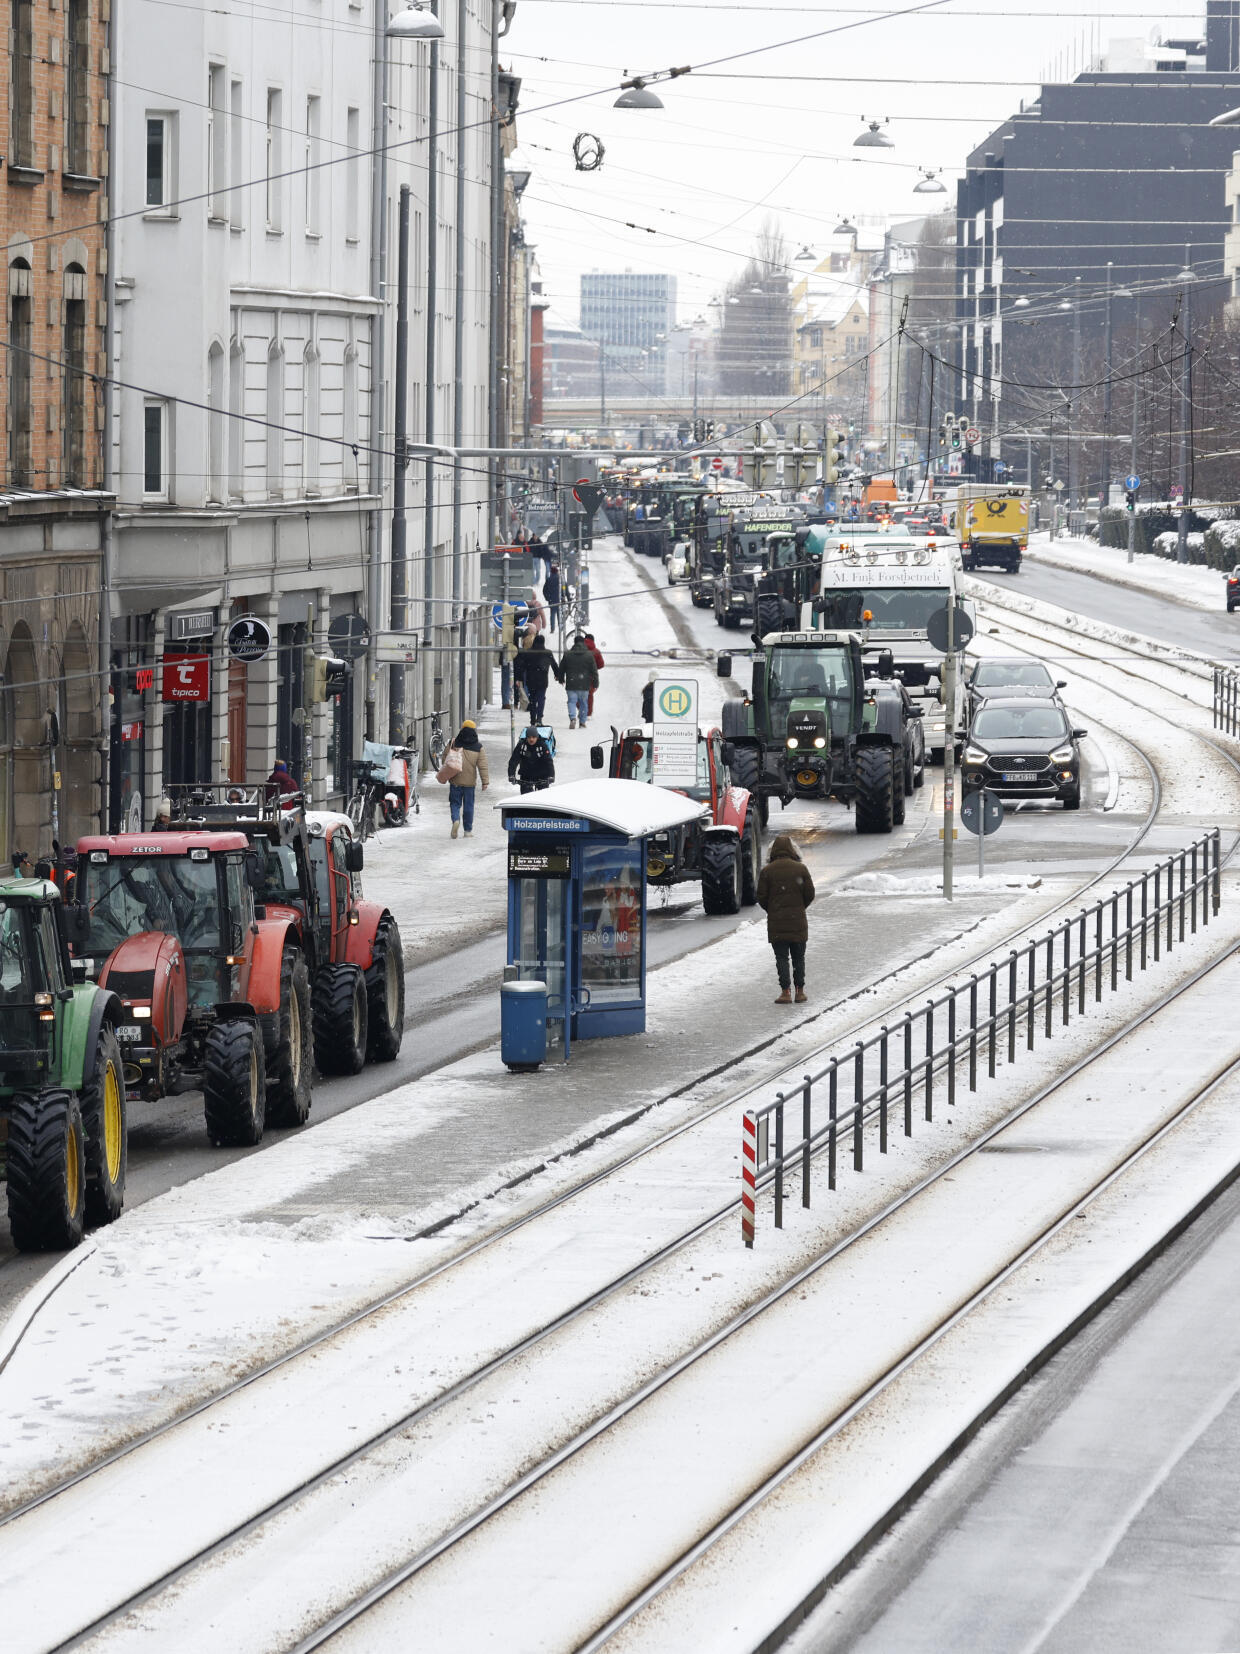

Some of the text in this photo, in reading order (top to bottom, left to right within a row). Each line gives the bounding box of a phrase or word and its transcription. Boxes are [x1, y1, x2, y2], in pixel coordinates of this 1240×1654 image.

[744, 523, 792, 532] HAFENEDER
[834, 571, 941, 583] M. Fink Forstbetrieb
[171, 687, 200, 697] tipico
[668, 692, 682, 711] H
[513, 819, 581, 830] Holzapfelstraße
